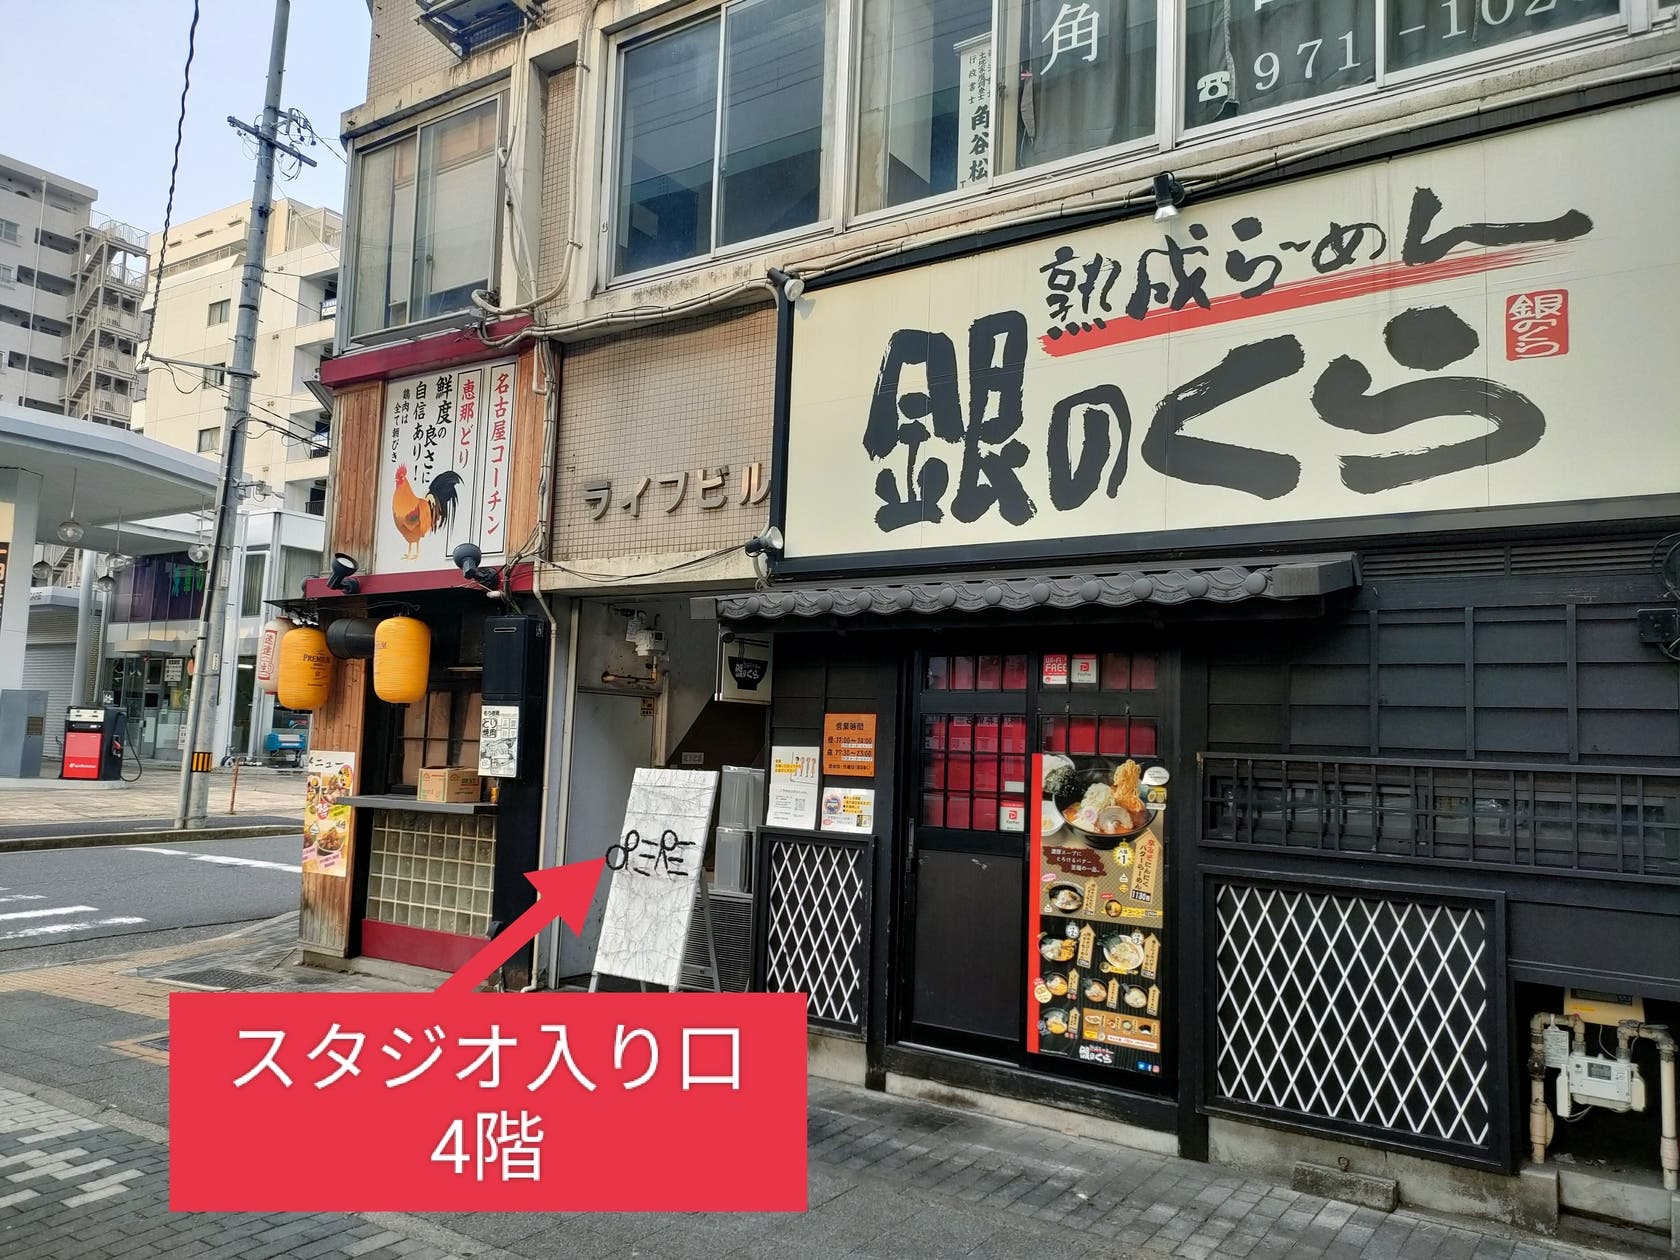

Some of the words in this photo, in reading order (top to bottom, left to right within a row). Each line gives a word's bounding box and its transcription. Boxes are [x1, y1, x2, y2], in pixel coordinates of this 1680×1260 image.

[1040, 3, 1100, 76] 角
[458, 379, 475, 469] 恵那どり
[487, 373, 510, 535] 名古屋コーチン
[863, 305, 1546, 533] 銀のくら
[584, 462, 772, 521] ライフビル
